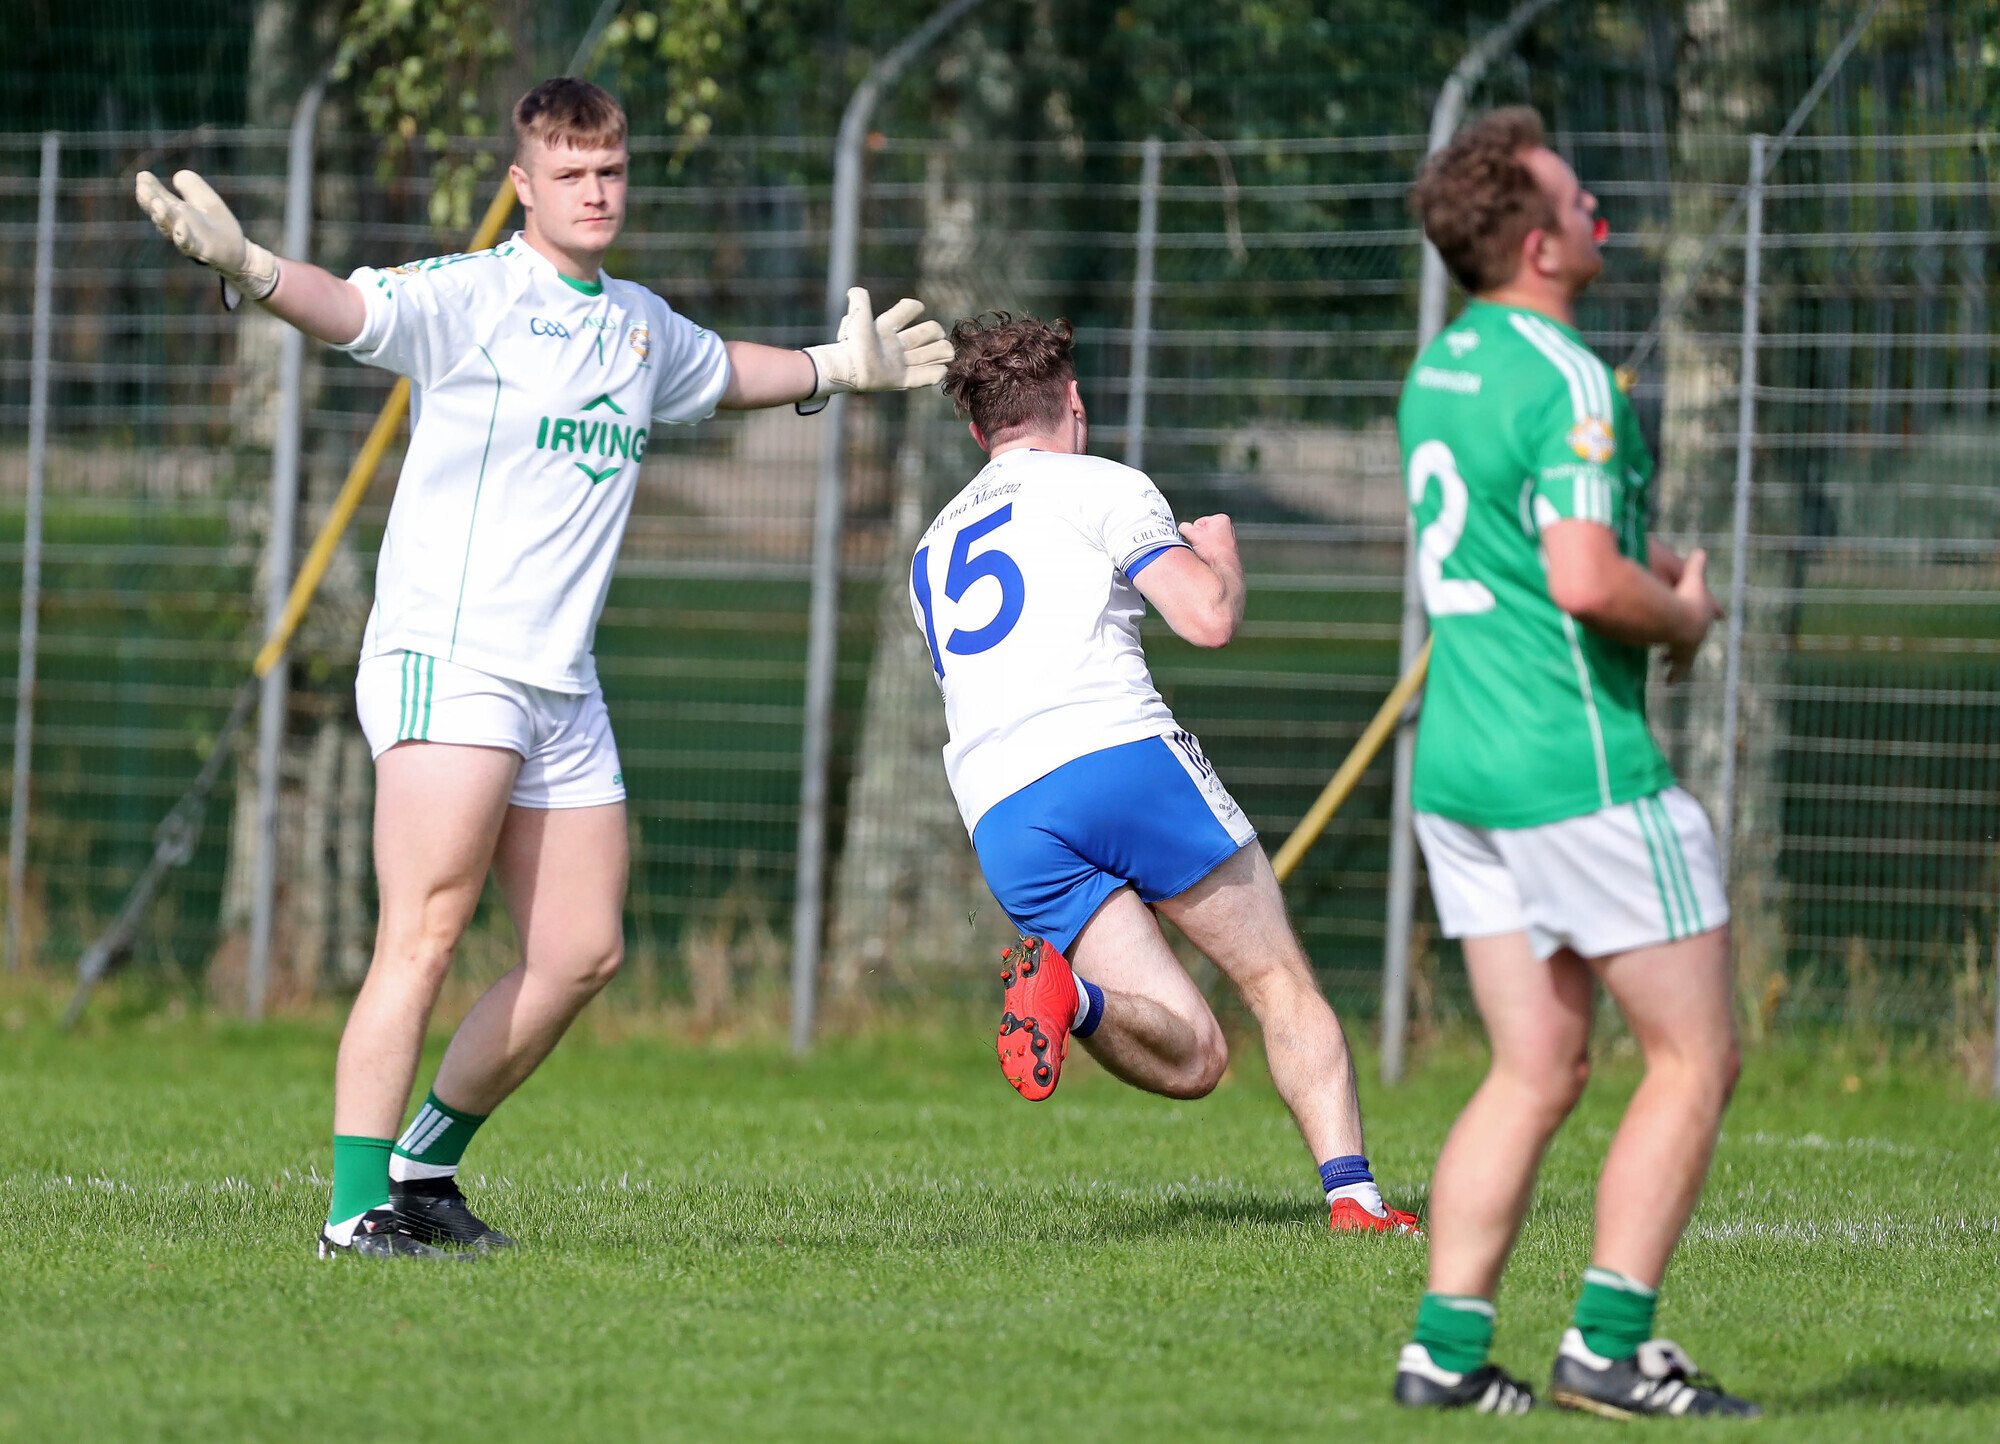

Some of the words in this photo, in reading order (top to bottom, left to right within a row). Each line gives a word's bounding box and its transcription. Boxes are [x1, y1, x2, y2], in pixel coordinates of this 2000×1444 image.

[536, 416, 647, 464] IRVING
[949, 503, 968, 521] na
[1408, 439, 1497, 617] 2
[1132, 529, 1157, 544] CILL
[912, 501, 1025, 681] 15
